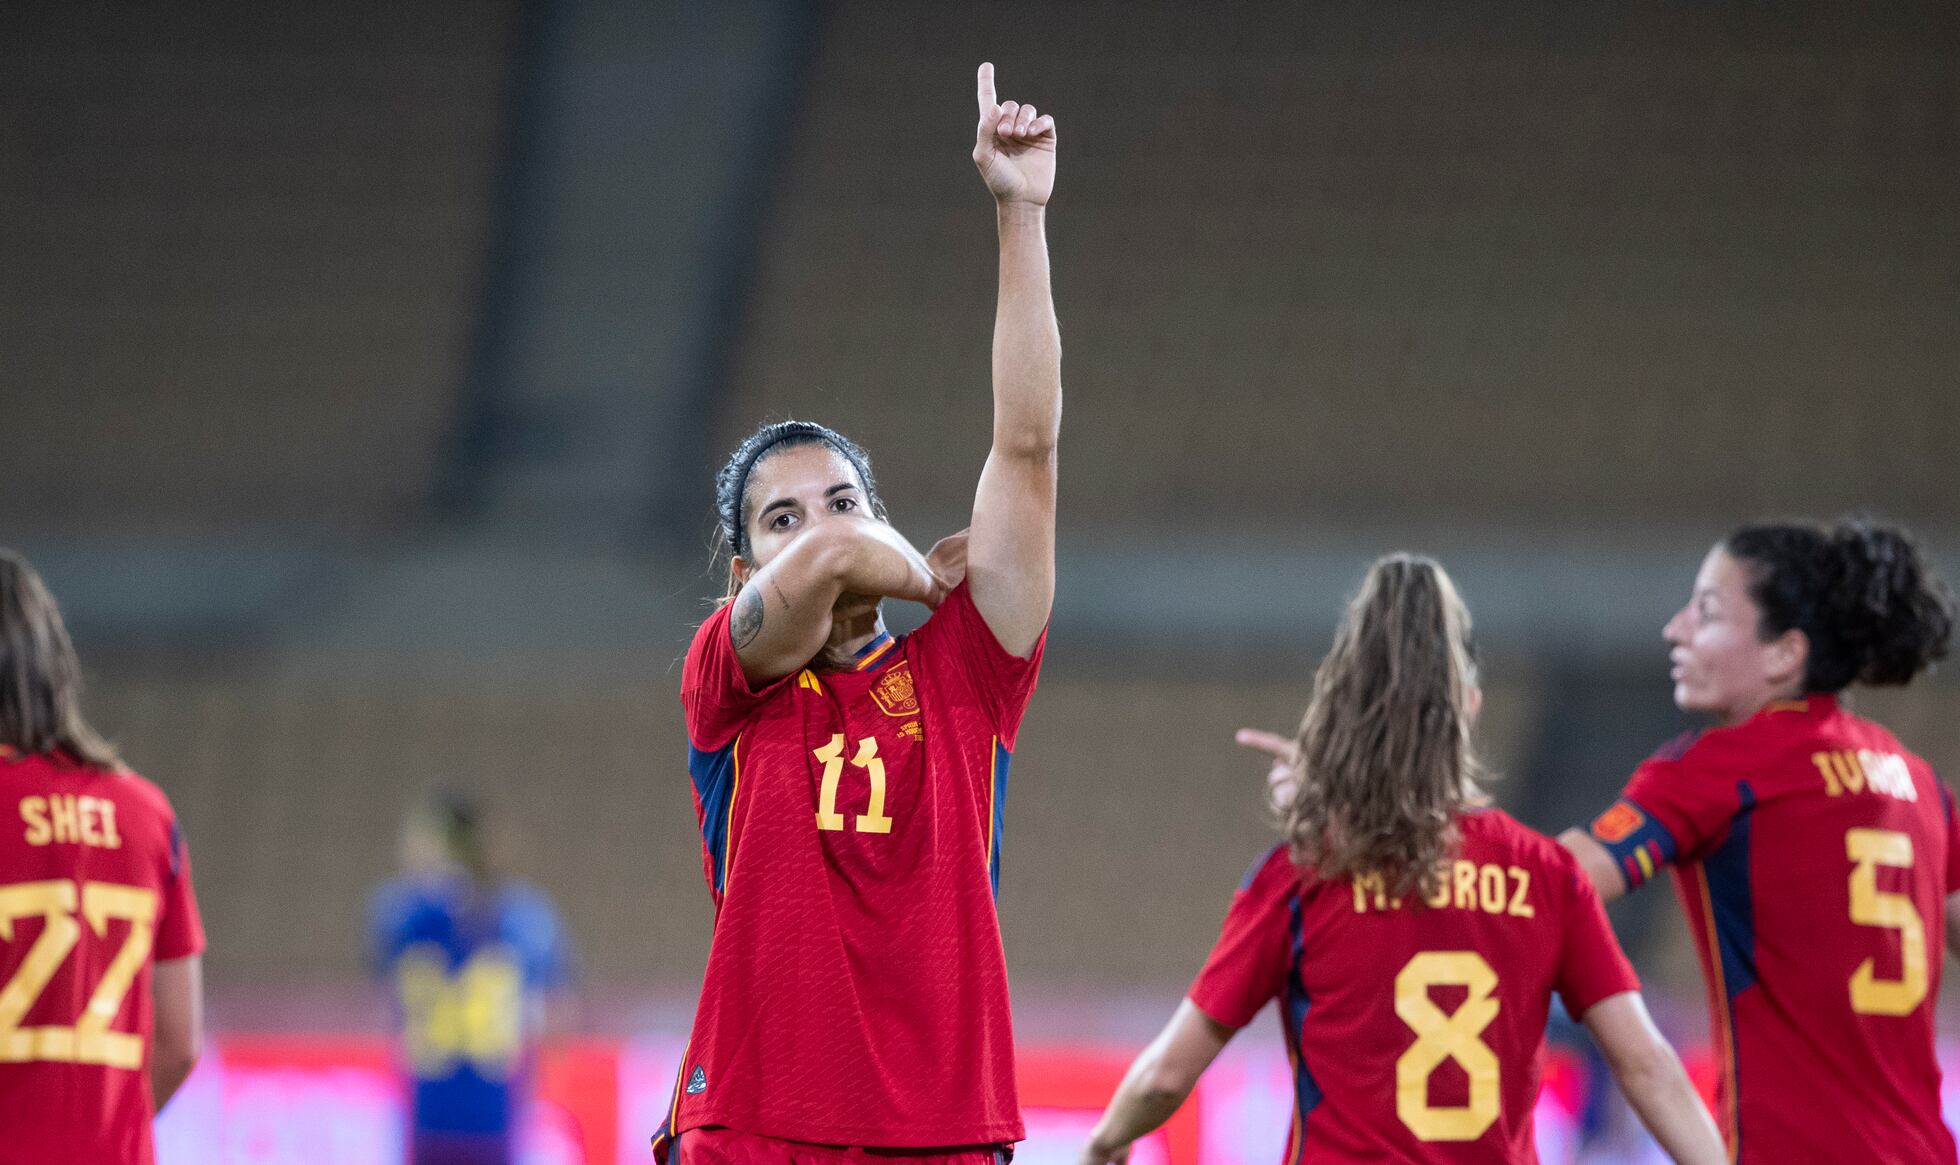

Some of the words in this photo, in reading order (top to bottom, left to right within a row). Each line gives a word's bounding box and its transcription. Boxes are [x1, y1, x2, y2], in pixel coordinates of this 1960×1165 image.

[19, 793, 122, 850] SHEI
[813, 733, 892, 833] 11
[0, 877, 158, 1071] 22
[1845, 827, 1928, 1016] 5
[1394, 950, 1501, 1142] 8
